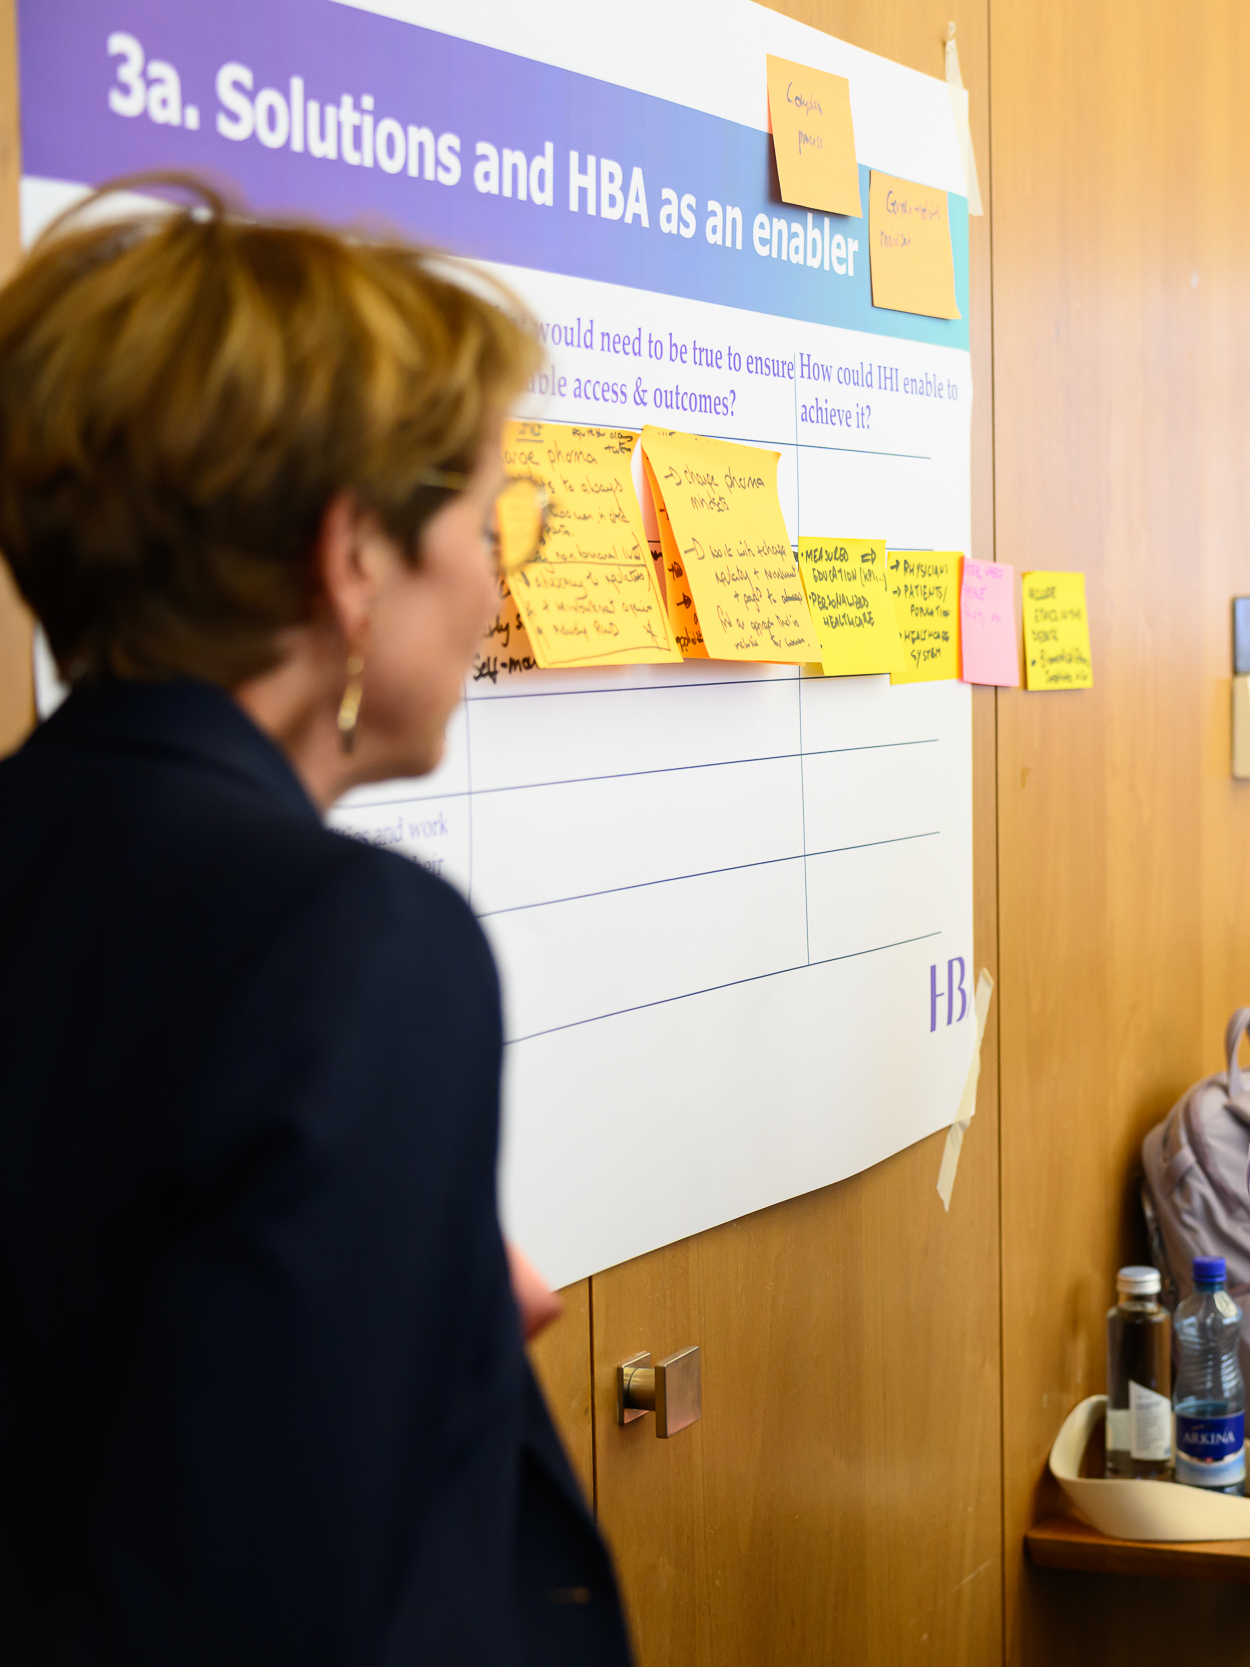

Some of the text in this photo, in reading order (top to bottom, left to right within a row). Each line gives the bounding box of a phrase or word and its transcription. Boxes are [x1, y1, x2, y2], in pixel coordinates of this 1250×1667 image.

[107, 32, 859, 277] 3a. Solutions and HBA as an enabler
[535, 317, 595, 350] would
[599, 327, 643, 358] need
[647, 332, 664, 362] to
[668, 333, 688, 365] be
[692, 344, 723, 371] true
[727, 348, 742, 373] to
[745, 353, 795, 381] ensure
[799, 352, 959, 402] How could IHI enable to
[573, 375, 628, 404] access
[632, 377, 648, 408] &
[652, 386, 737, 418] outcomes?
[799, 402, 872, 431] achieve it?
[805, 546, 849, 563] MEASURED
[812, 565, 857, 583] EDUCATION
[811, 592, 869, 611] PERSONALIZED
[822, 611, 875, 629] HEALTHCARE
[910, 648, 942, 668] SYSTEM
[408, 811, 449, 838] work
[929, 956, 967, 1033] HB
[1182, 1430, 1236, 1446] ARKINA
